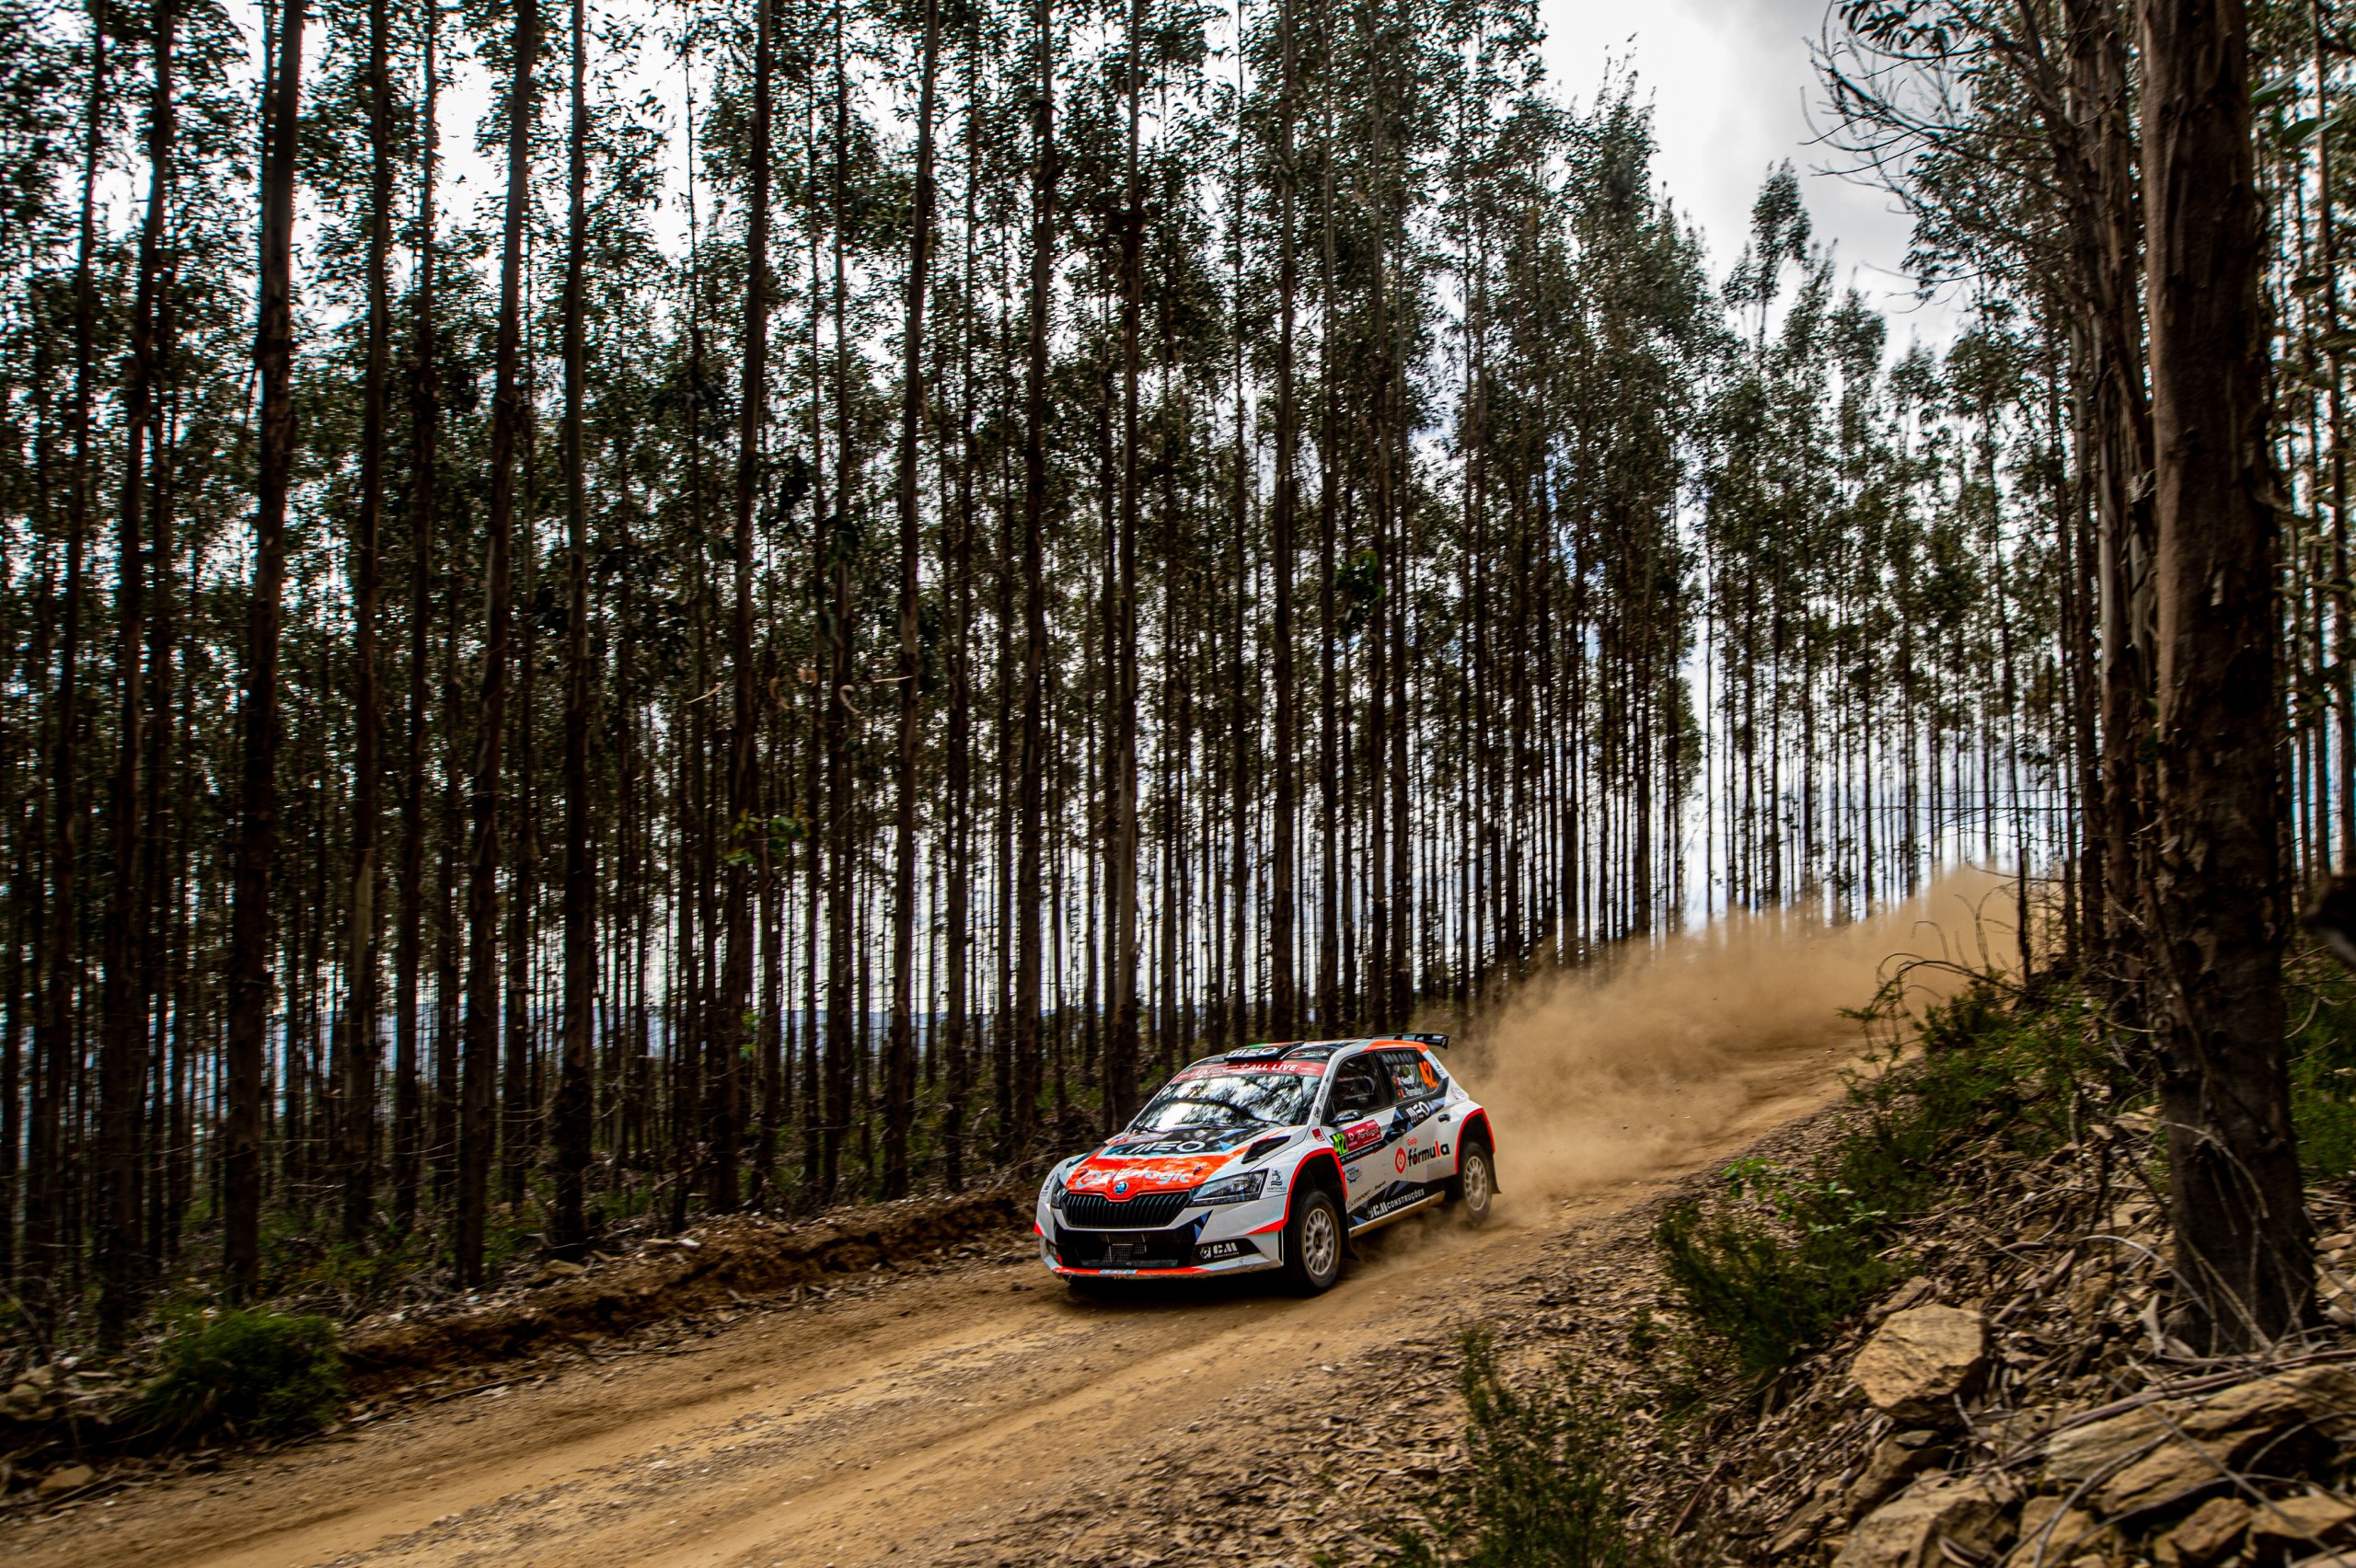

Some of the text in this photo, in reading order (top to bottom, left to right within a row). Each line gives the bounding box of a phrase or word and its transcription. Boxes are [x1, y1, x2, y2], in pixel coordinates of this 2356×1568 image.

[1249, 1064, 1268, 1072] ALL
[1271, 1064, 1299, 1072] LIVE
[1418, 1060, 1438, 1089] 42
[1332, 1132, 1349, 1156] 42
[1408, 1140, 1450, 1168] fórmula
[1387, 1188, 1426, 1209] CONSTRUÇÕES
